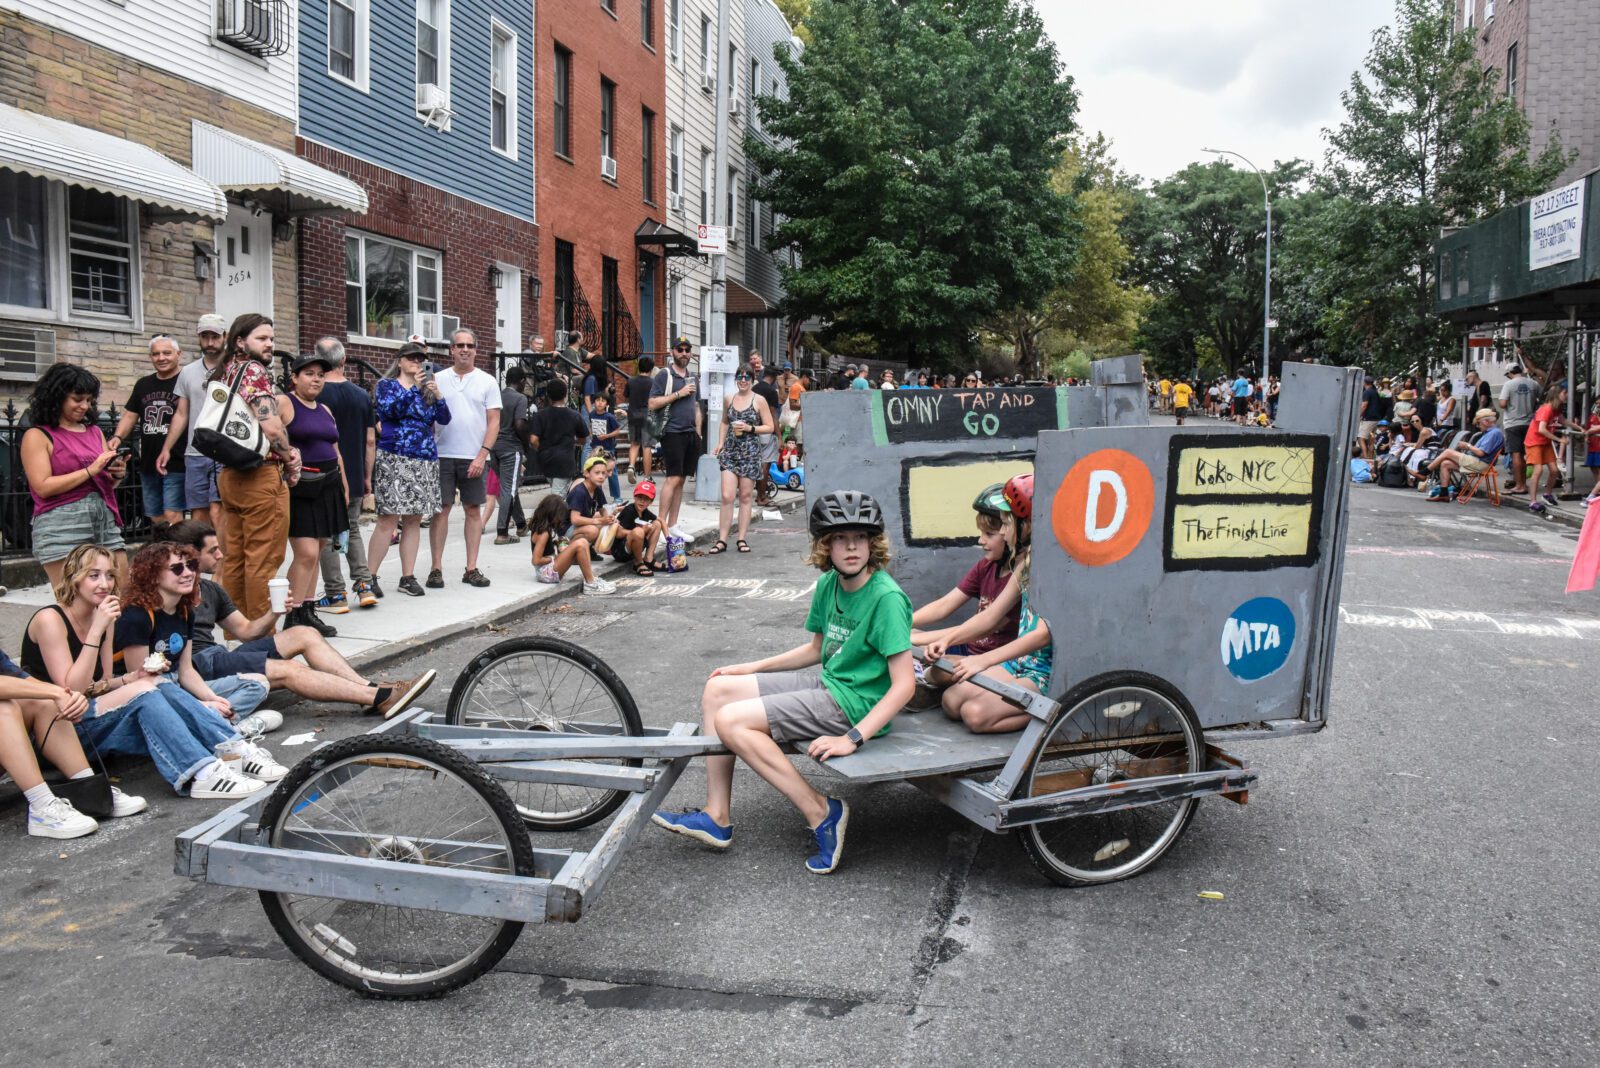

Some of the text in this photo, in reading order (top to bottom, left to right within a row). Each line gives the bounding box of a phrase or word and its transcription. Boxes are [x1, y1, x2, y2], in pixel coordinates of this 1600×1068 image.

[1546, 195, 1555, 211] 17
[1556, 187, 1579, 208] STREET
[229, 270, 251, 286] 265A
[887, 392, 1036, 425] OMNY TAP AND
[963, 410, 1000, 436] GO
[1242, 459, 1277, 482] NYC
[1084, 469, 1128, 542] D
[1181, 516, 1288, 542] The Finish Line
[1221, 617, 1280, 666] MTA
